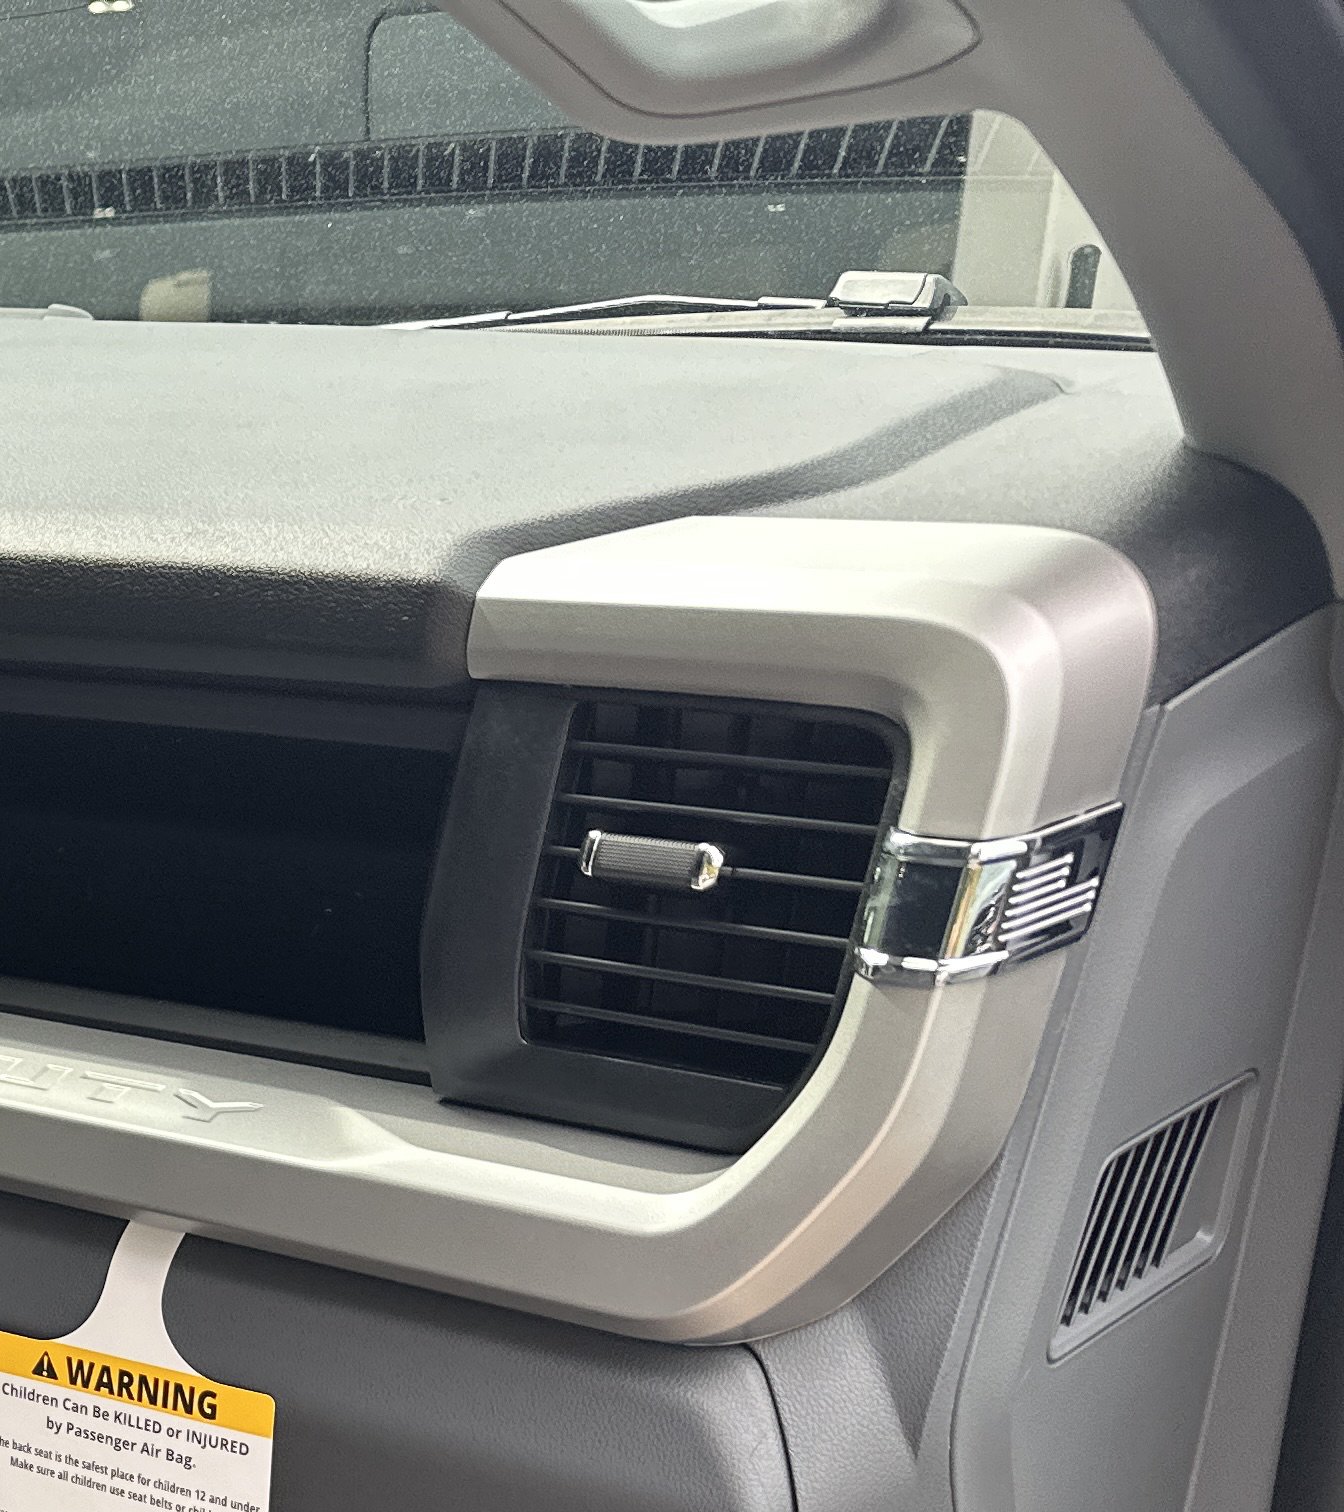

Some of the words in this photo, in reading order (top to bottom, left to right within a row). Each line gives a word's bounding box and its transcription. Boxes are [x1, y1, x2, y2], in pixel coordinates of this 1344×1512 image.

[2, 1382, 58, 1408] Children
[63, 1398, 88, 1416] Can
[92, 1405, 110, 1421] Be
[113, 1410, 162, 1434] KILLED
[166, 1427, 182, 1440] or
[186, 1428, 250, 1456] INJURED
[65, 1355, 218, 1421] WARNING
[12, 1438, 32, 1454] back
[34, 1446, 52, 1460] seat
[55, 1450, 62, 1463] is
[65, 1454, 80, 1467] the
[81, 1459, 109, 1476] safest
[110, 1467, 135, 1483] place
[137, 1473, 151, 1487] for
[153, 1478, 192, 1498] children
[194, 1489, 206, 1501] 12
[208, 1494, 227, 1507] and
[46, 1416, 63, 1435] by
[66, 1421, 137, 1452] Passenger
[140, 1442, 162, 1459] Air
[165, 1448, 196, 1470] Bag.
[10, 1456, 34, 1472] Make
[36, 1465, 55, 1478] sure
[57, 1470, 69, 1482] all
[70, 1474, 107, 1493] children
[109, 1485, 125, 1498] use
[128, 1490, 147, 1504] seat
[149, 1495, 173, 1511] belts
